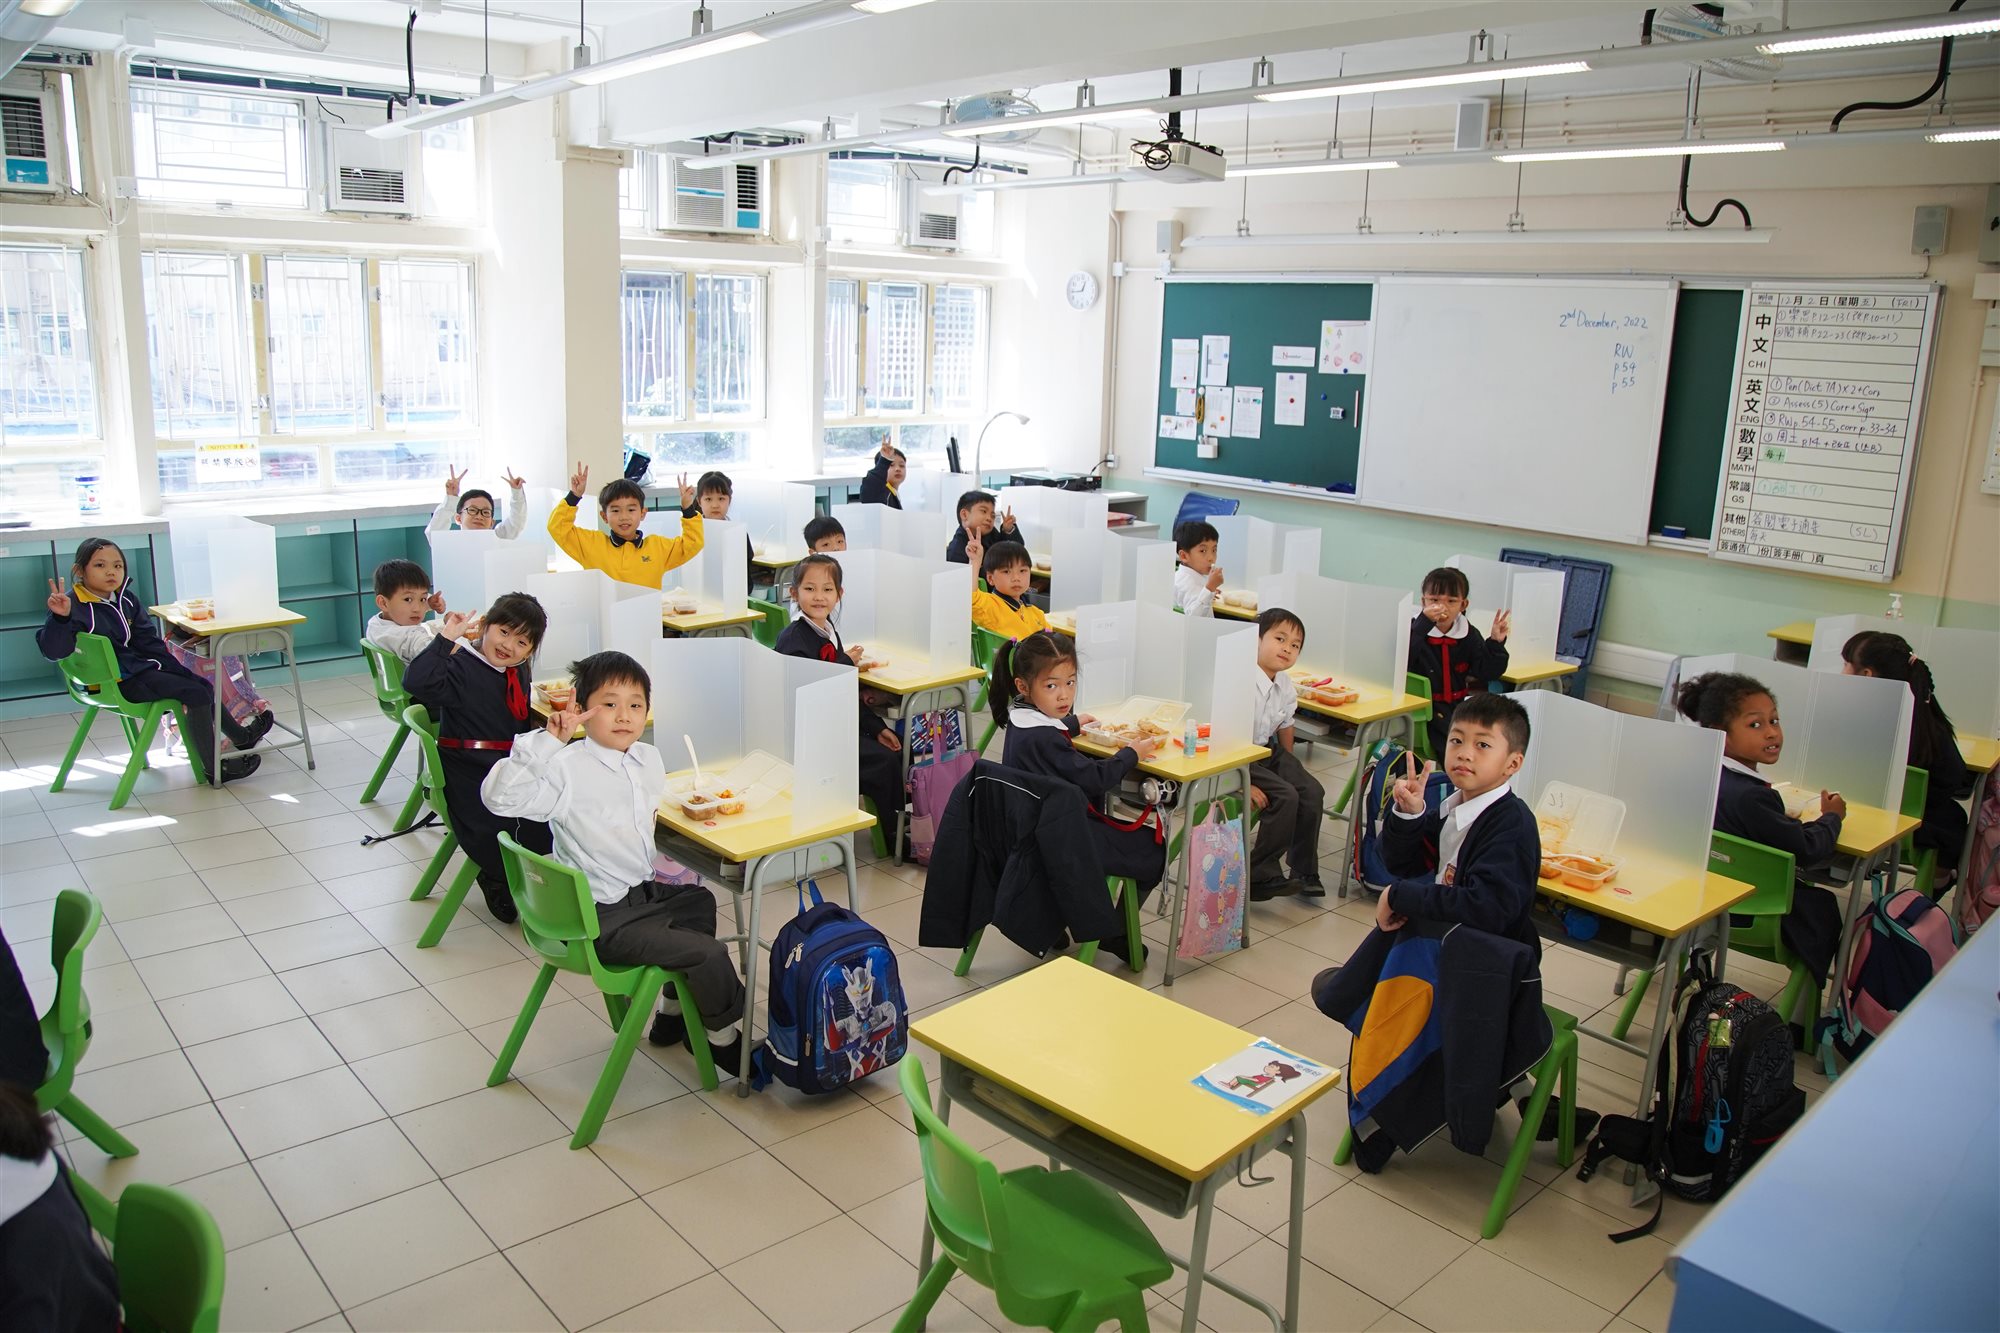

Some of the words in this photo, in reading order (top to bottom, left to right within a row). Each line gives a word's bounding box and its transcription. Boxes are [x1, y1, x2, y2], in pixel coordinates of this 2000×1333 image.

[1559, 308, 1576, 327] 2nd
[1577, 309, 1619, 330] December,
[1624, 315, 1648, 329] 2022
[1752, 313, 1771, 353] 中文
[1614, 342, 1634, 358] RW
[1748, 360, 1767, 369] CHI
[1743, 379, 1763, 413] 英文
[1740, 415, 1760, 424] ENG
[1736, 428, 1756, 462] 數學
[1731, 463, 1755, 473] MATH
[1729, 480, 1751, 492] 常識
[1731, 495, 1745, 504] GS
[1724, 513, 1746, 526] 其他
[1721, 527, 1746, 538] OTHERS
